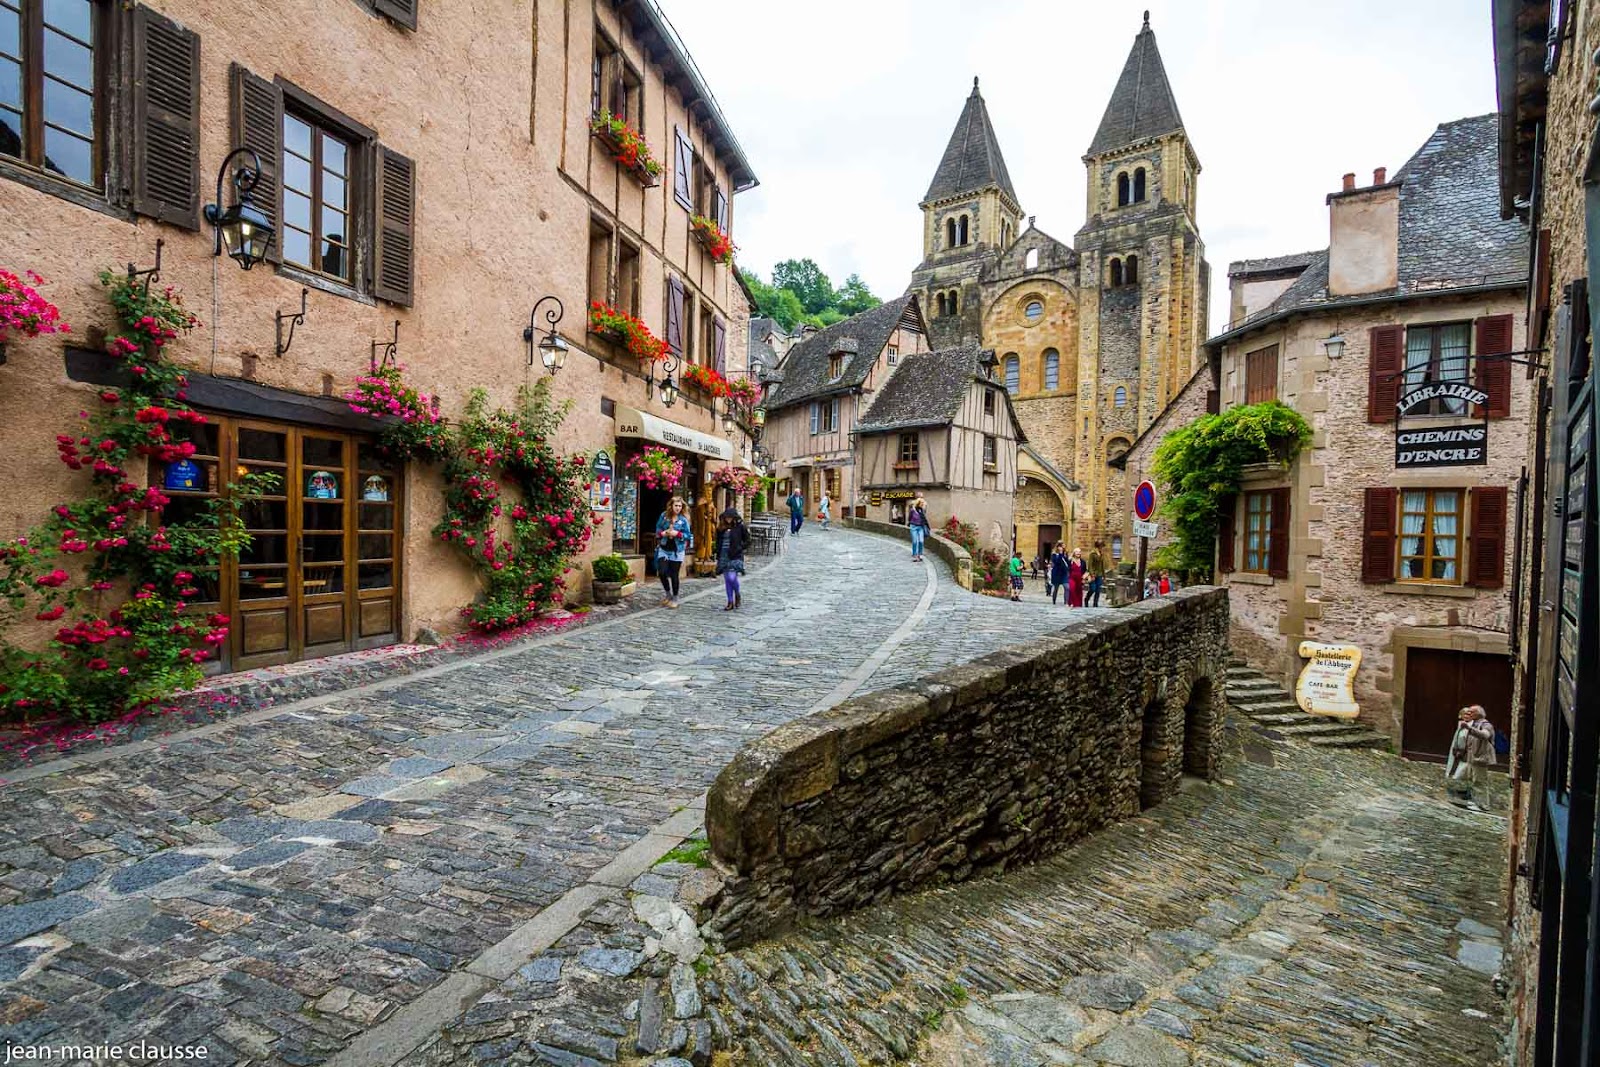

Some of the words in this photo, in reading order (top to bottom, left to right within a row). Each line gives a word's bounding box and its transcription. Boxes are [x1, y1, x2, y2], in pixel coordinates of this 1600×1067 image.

[1396, 384, 1489, 413] LIBRAIRIE
[620, 425, 638, 433] BAR
[1397, 428, 1485, 445] CHEMINS
[662, 430, 692, 447] RESTAURANT
[1397, 448, 1481, 463] D'ENCRE
